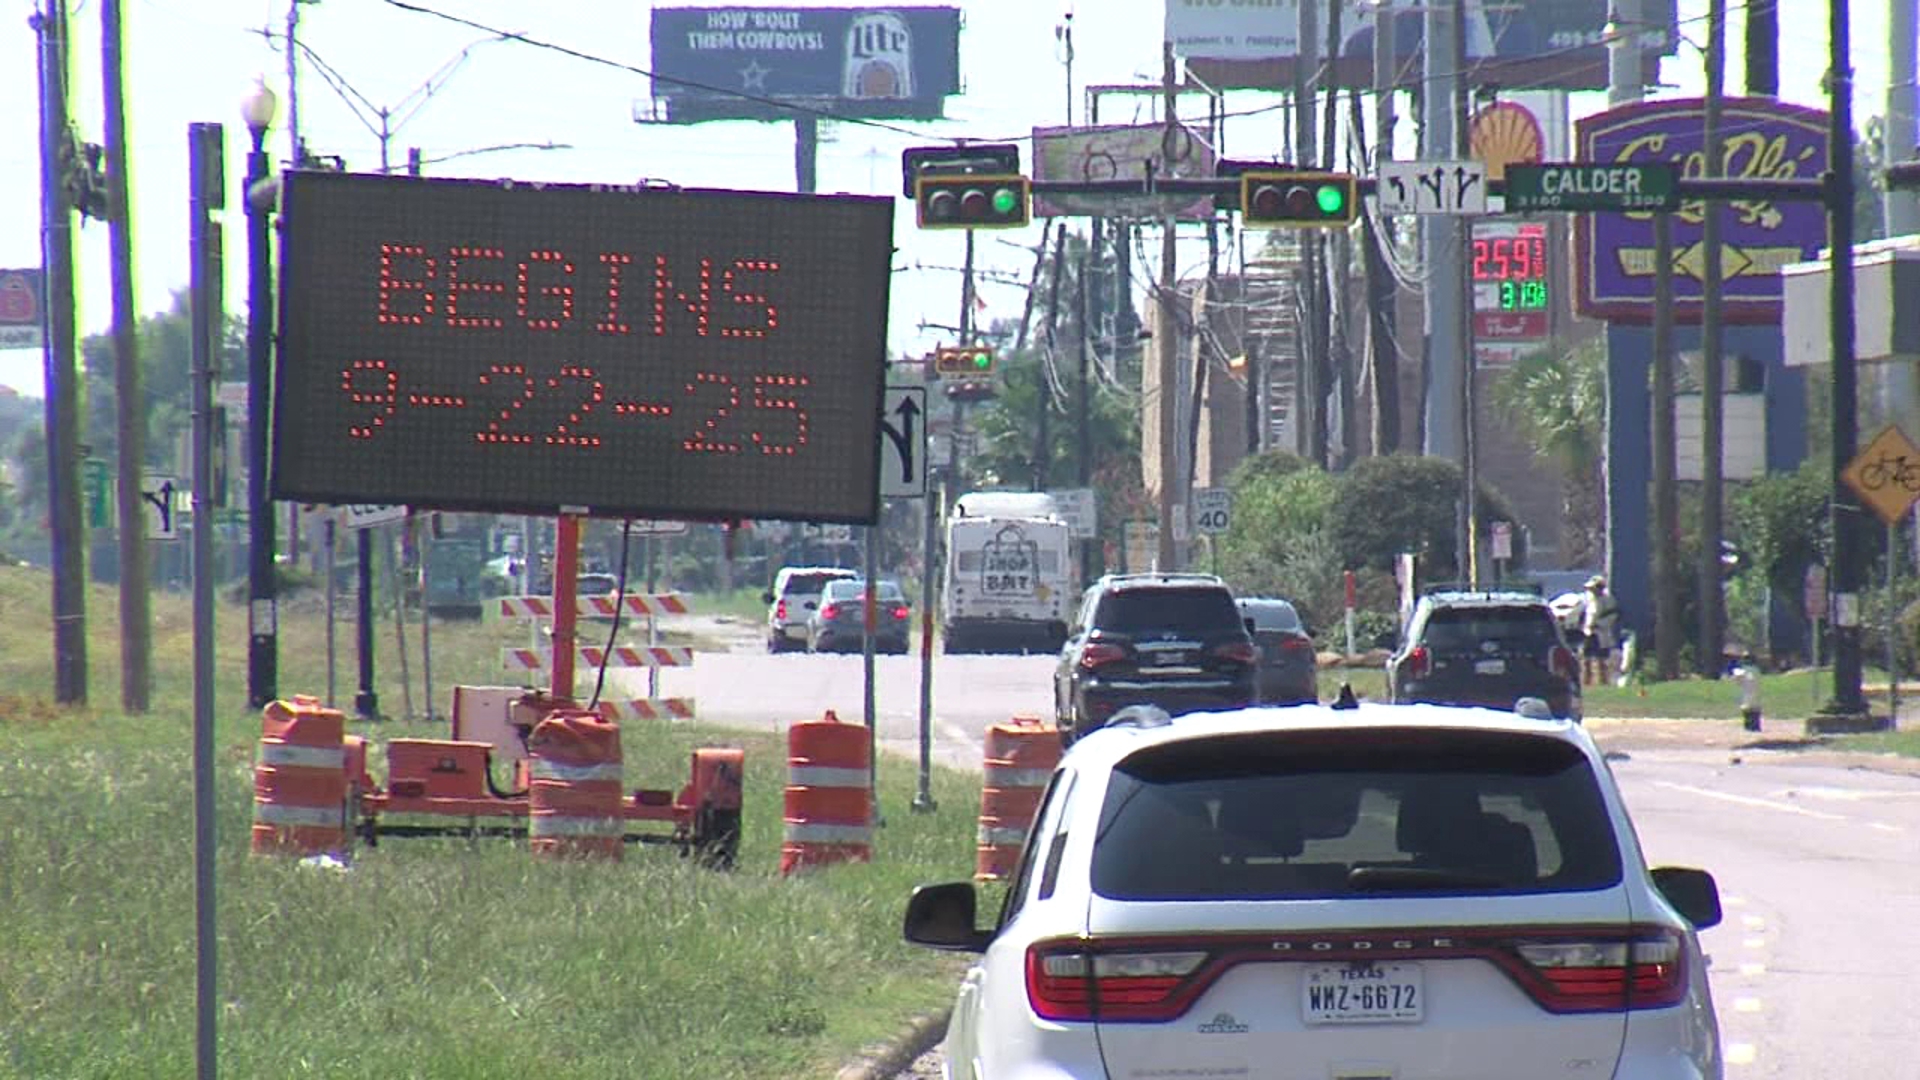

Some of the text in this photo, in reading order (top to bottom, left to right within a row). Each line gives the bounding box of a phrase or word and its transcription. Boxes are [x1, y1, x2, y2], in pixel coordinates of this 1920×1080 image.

[707, 11, 748, 29] HOW
[687, 32, 824, 50] THEM COWBOYS!
[1541, 168, 1642, 194] CALDER
[378, 244, 780, 338] BEGINS
[341, 360, 809, 456] 9-22-25
[1198, 511, 1228, 528] 40
[1273, 938, 1452, 951] DODGE
[1340, 967, 1386, 980] TEXAS
